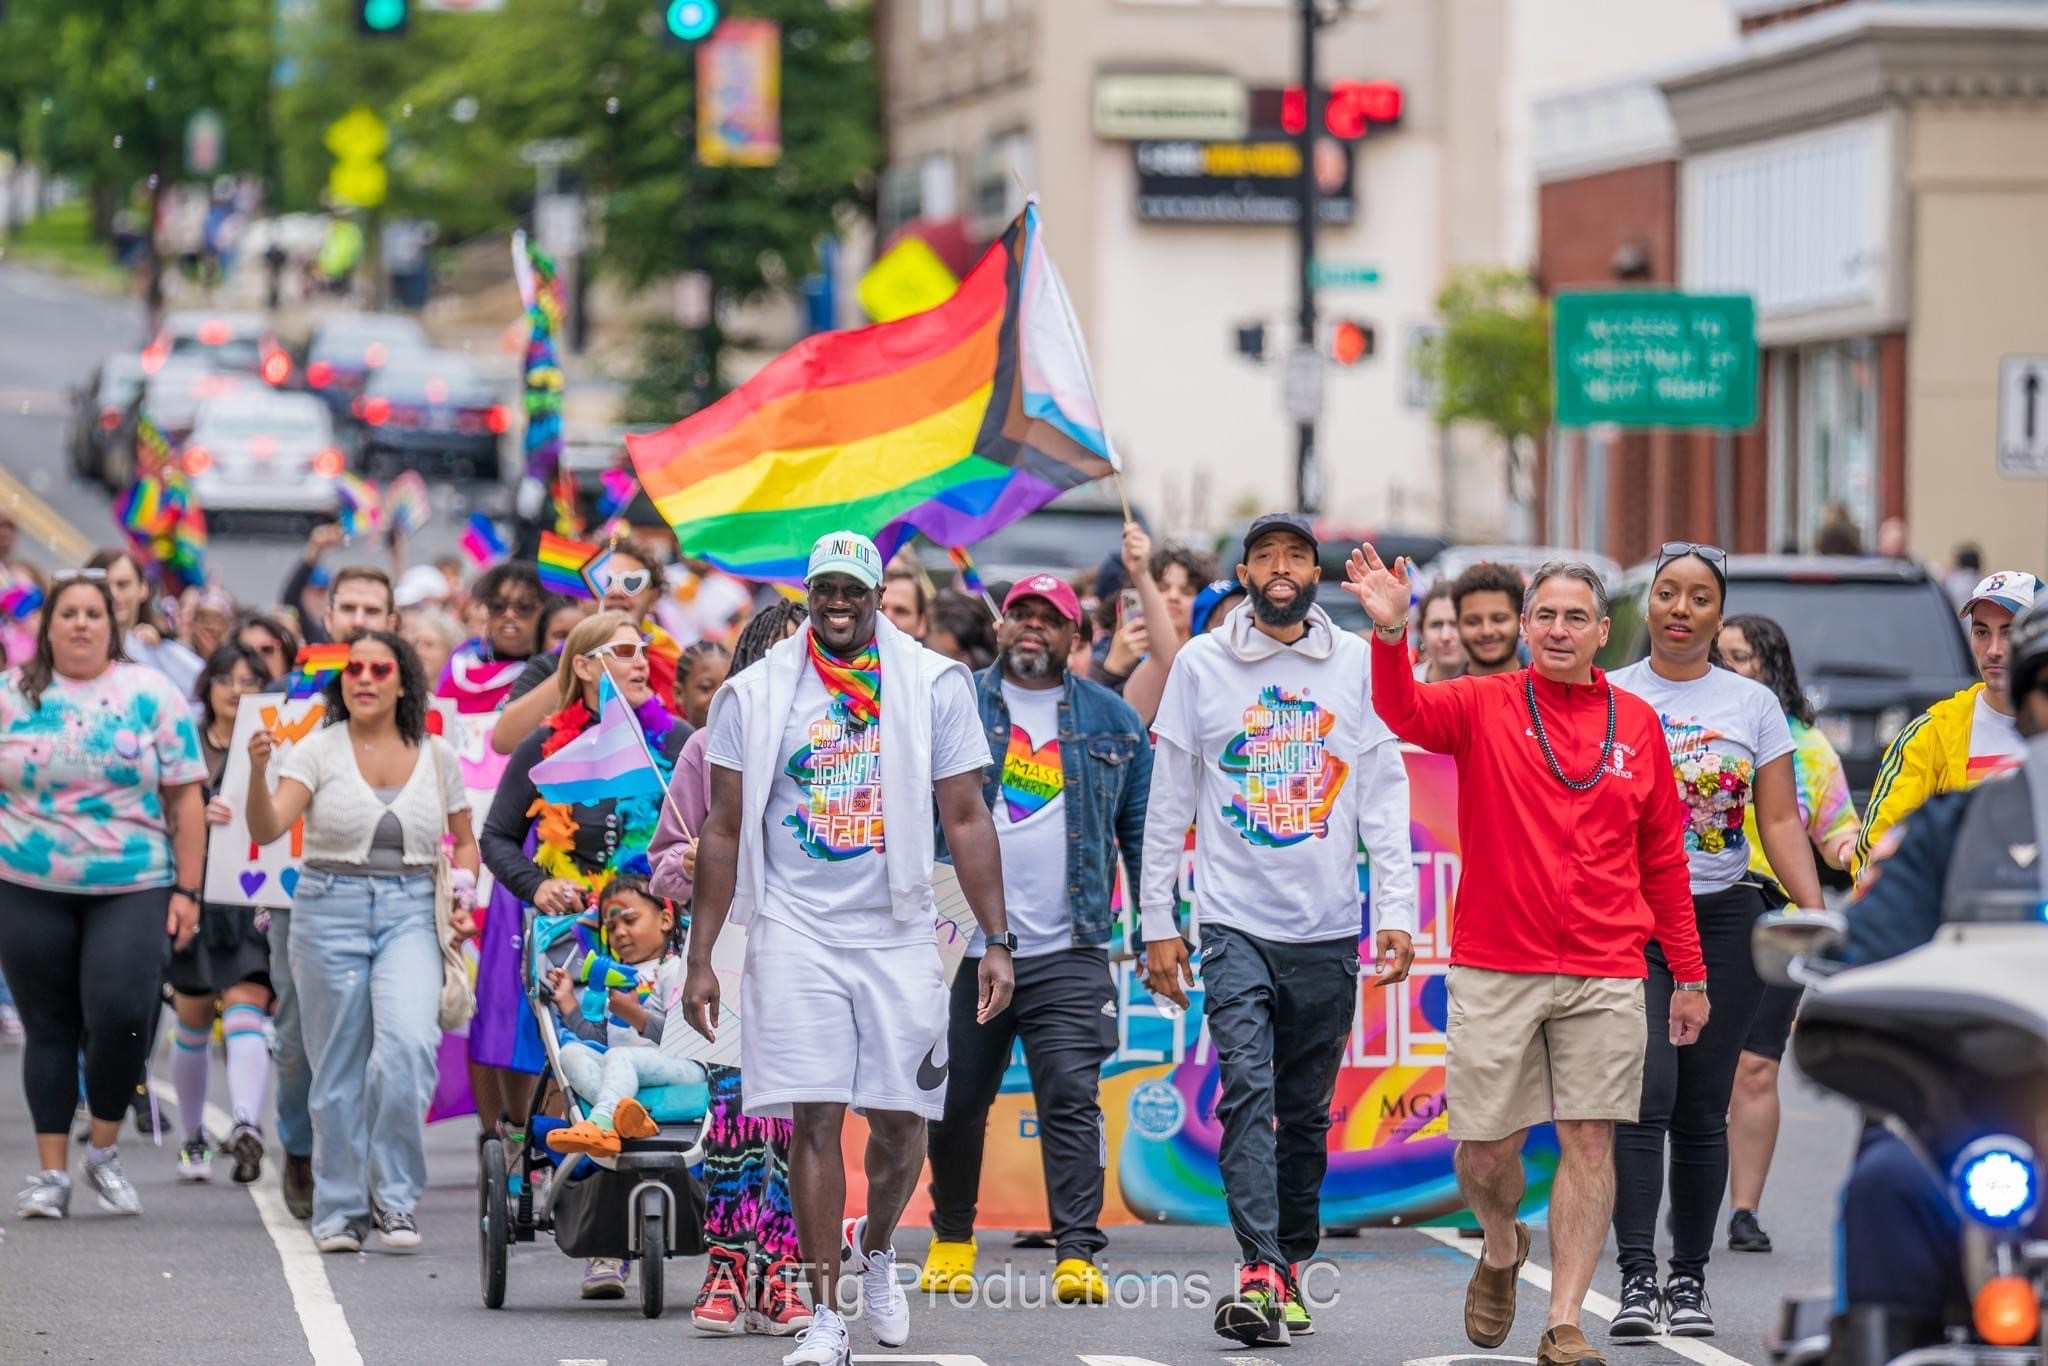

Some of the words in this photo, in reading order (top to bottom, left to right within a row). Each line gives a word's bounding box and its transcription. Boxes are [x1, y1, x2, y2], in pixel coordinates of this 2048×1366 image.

[818, 739, 837, 749] 2023
[810, 752, 881, 784] SPRINGFIEL
[1613, 749, 1624, 770] S
